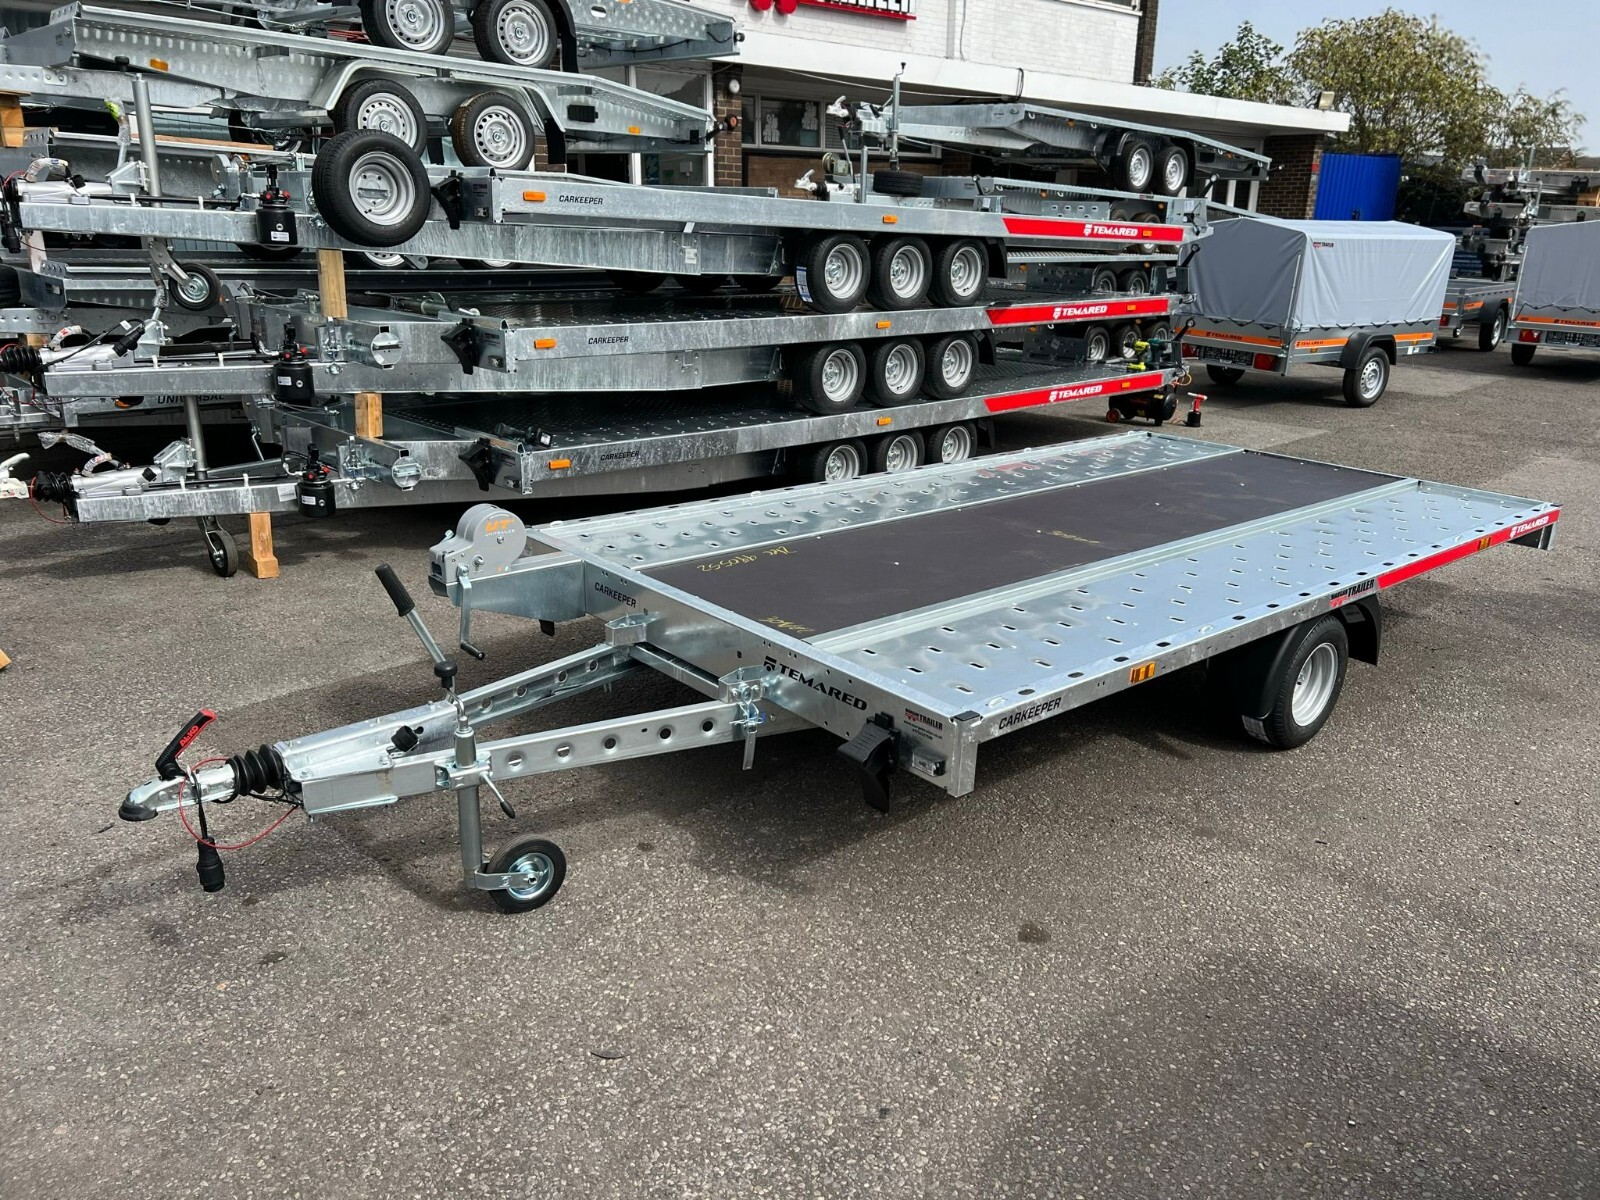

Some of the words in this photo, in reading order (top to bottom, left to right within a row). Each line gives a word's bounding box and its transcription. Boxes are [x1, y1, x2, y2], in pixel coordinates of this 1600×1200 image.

[558, 194, 604, 205] CARKEEPER
[1093, 225, 1138, 237] TEMARED
[1062, 305, 1108, 317] TEMARED
[587, 335, 630, 345] CARKEEPER
[1058, 384, 1103, 399] TEMARED
[594, 581, 637, 609] CARKEEPER
[779, 663, 868, 711] TEMARED
[998, 697, 1062, 730] CARKEEPER
